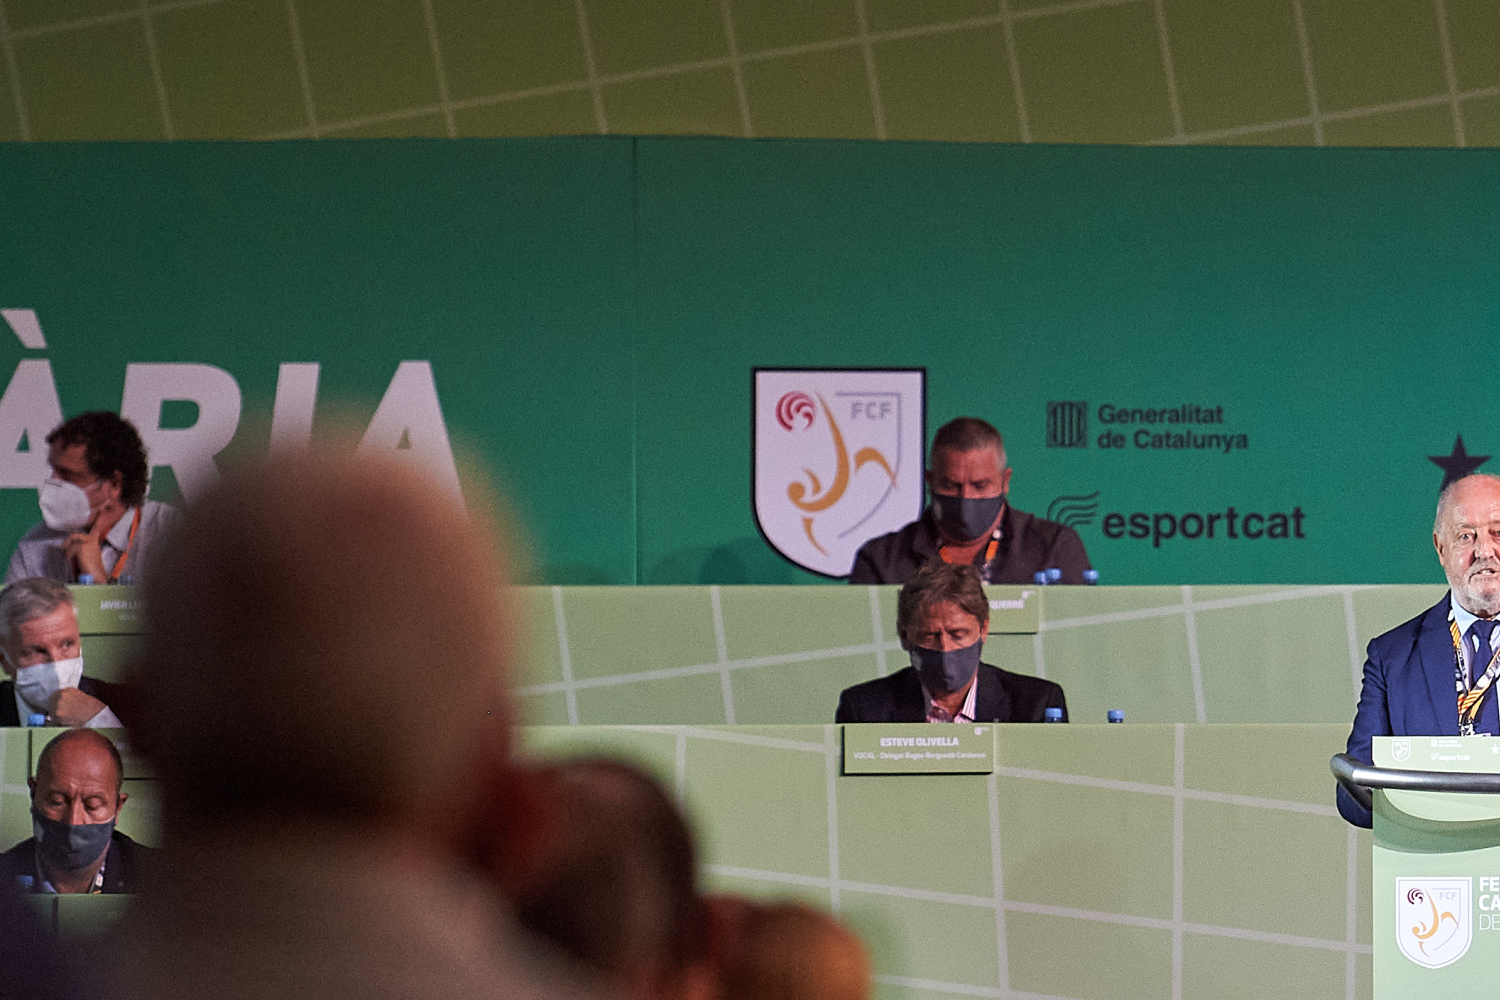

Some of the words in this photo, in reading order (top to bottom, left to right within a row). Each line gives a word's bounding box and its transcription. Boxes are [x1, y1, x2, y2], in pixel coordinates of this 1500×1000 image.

[851, 401, 891, 420] FCF
[1097, 404, 1223, 425] Generalitat
[1097, 429, 1126, 449] de
[1133, 428, 1249, 454] Catalunya
[1102, 506, 1306, 548] esportcat
[880, 737, 915, 747] ESTEVE
[915, 737, 959, 747] OLIVELLA
[1439, 891, 1457, 900] FCF
[1479, 913, 1500, 930] DE
